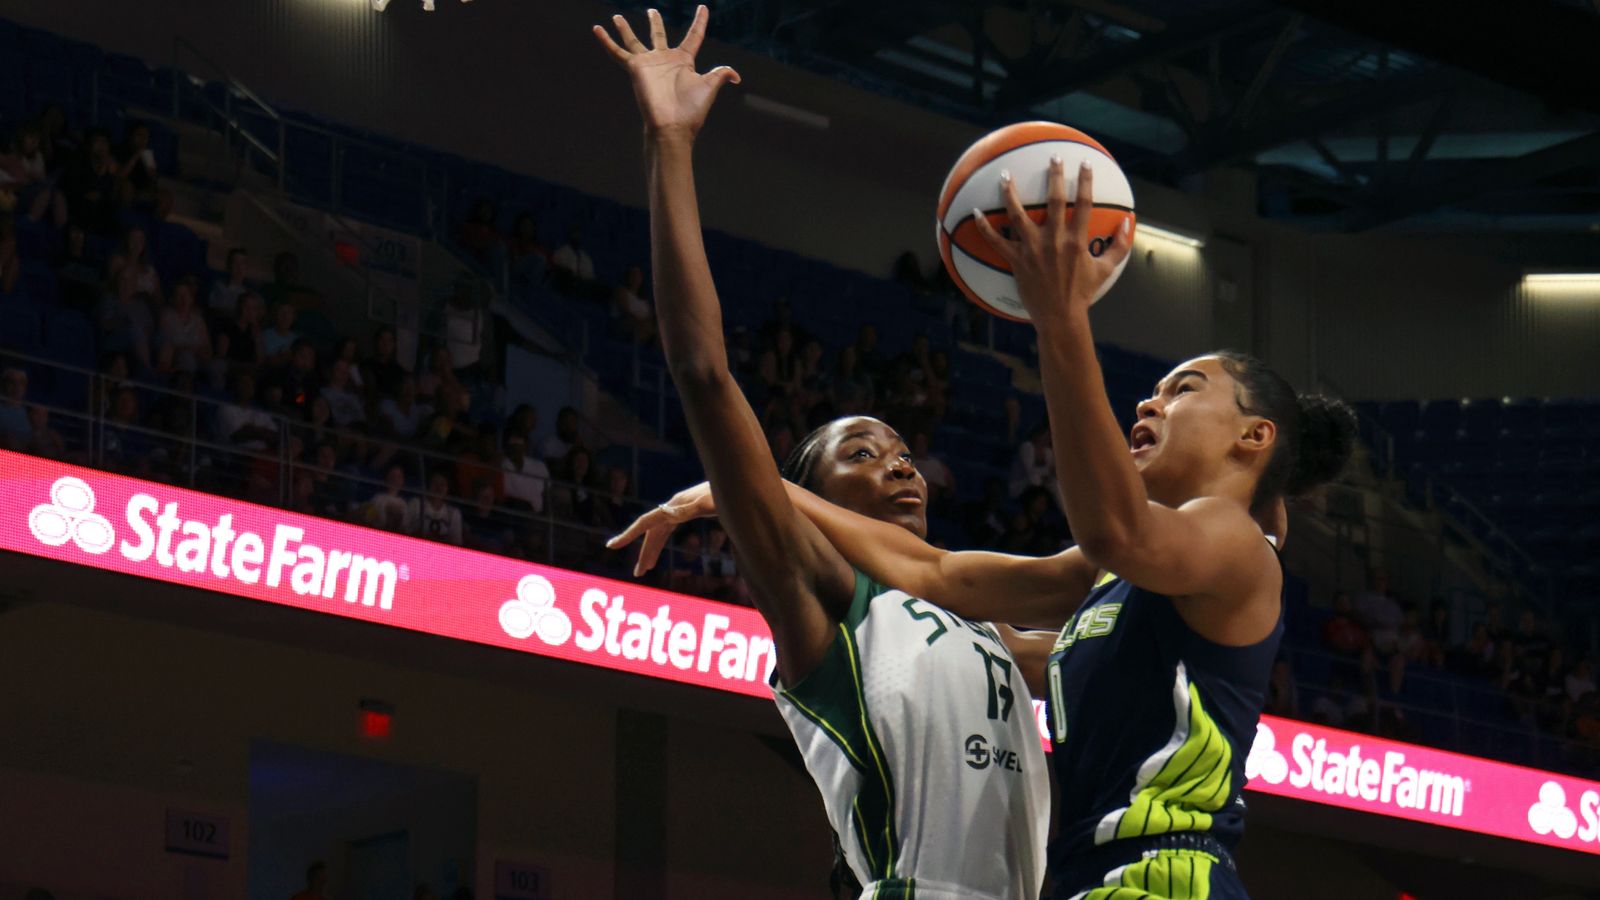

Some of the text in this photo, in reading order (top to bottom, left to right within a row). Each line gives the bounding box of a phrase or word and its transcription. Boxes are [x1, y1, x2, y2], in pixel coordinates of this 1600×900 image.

[1050, 602, 1123, 655] LAS
[183, 820, 217, 845] 102
[1577, 789, 1600, 844] S
[510, 870, 539, 893] 103
